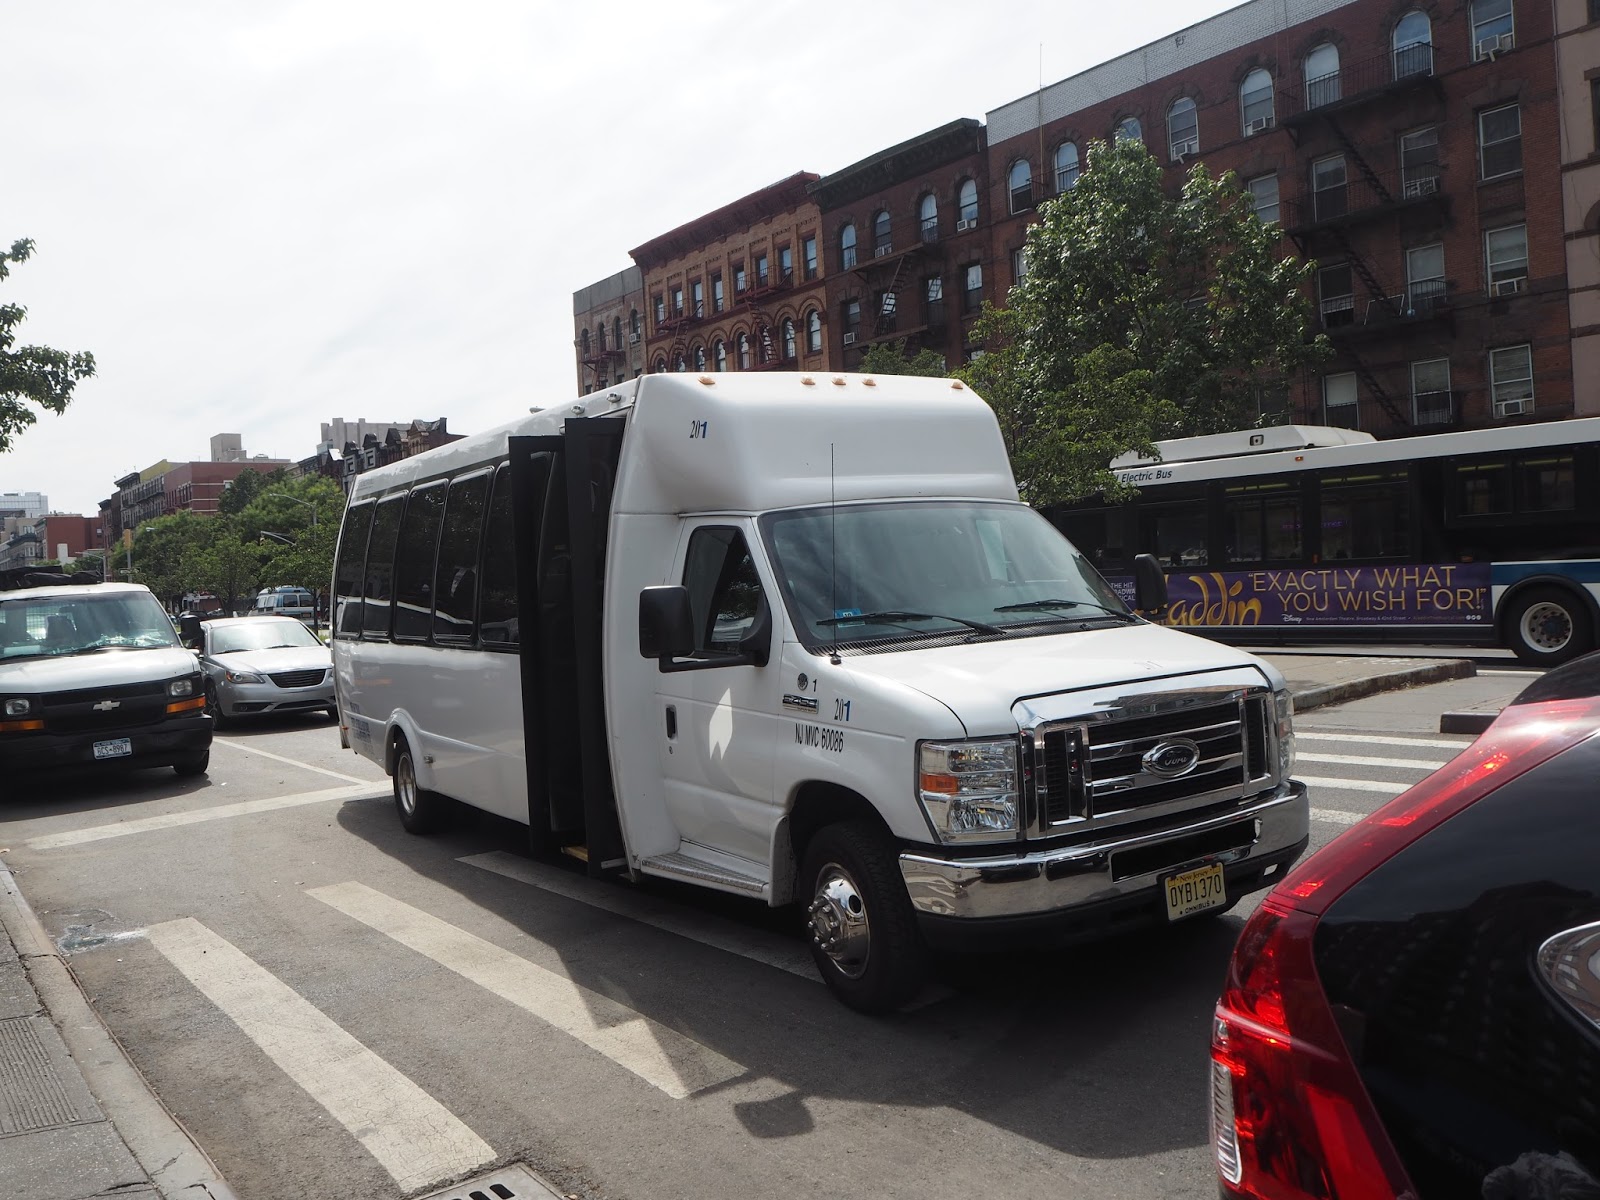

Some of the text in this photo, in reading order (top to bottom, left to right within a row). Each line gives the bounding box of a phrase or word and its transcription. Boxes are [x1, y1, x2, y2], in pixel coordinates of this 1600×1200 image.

[689, 419, 708, 439] 201
[1121, 471, 1154, 483] Electric
[1155, 470, 1173, 480] Bus
[1374, 566, 1456, 588] WHAT
[1164, 572, 1262, 626] addin
[1278, 592, 1329, 611] YOU
[1338, 590, 1406, 610] WISH
[1281, 613, 1303, 624] Disney
[812, 678, 818, 692] 1
[834, 698, 851, 722] 201
[795, 723, 844, 753] NJ MVC 60086
[1179, 870, 1209, 883] New Jersey
[1184, 900, 1211, 914] OMNIBUS
